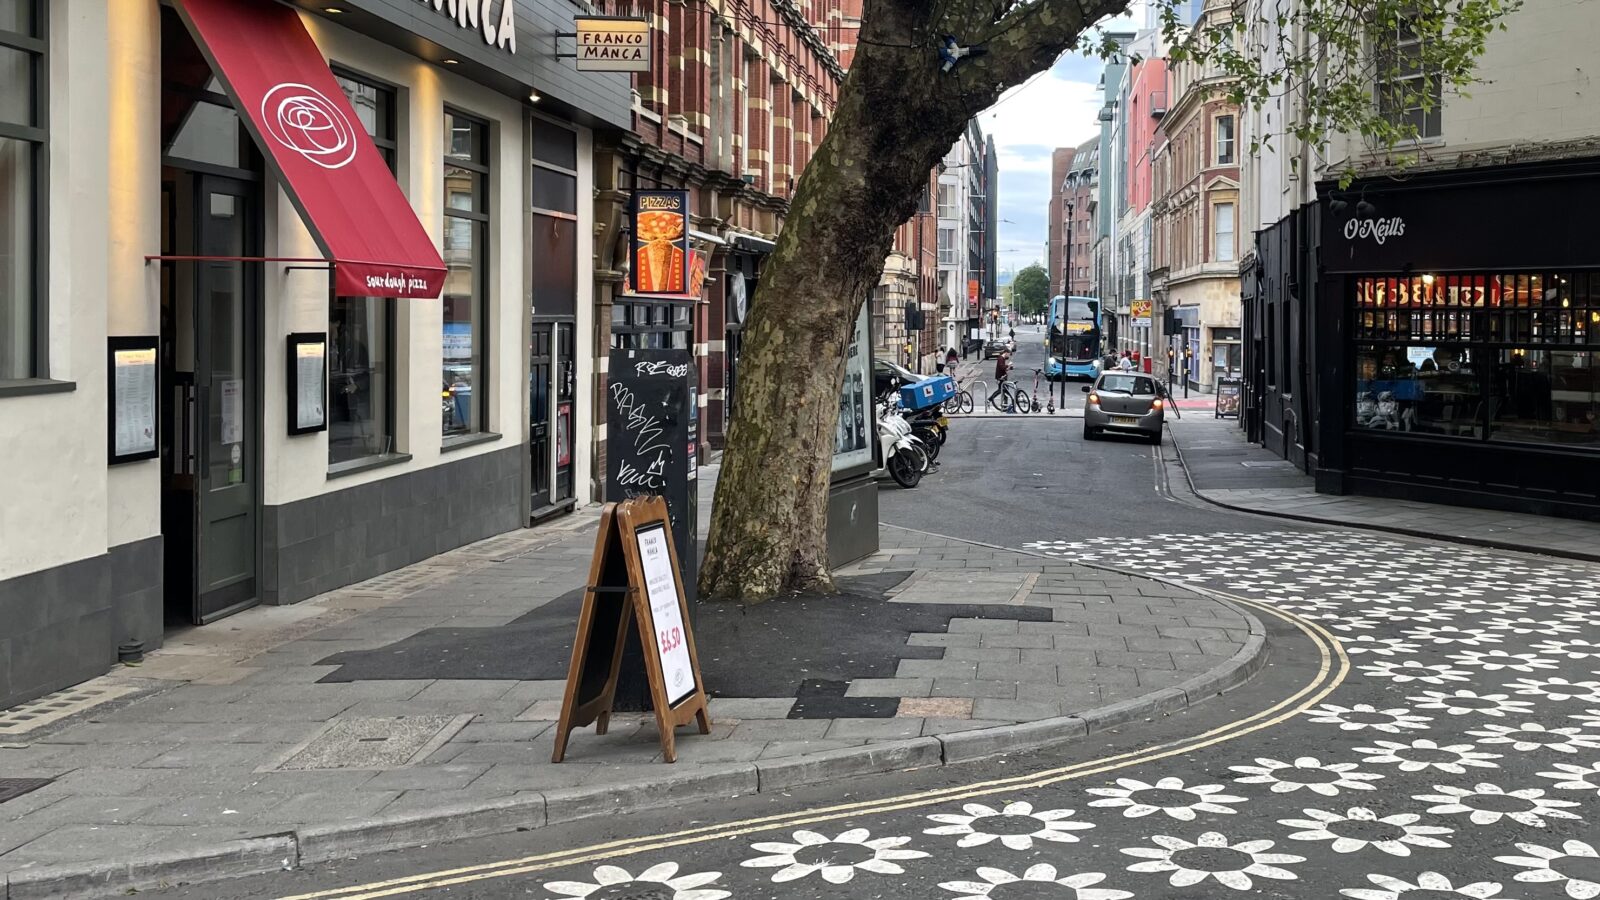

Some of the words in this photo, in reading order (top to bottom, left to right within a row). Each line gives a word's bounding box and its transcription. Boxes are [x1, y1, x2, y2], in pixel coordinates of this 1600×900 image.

[583, 33, 642, 44] FRANCO
[584, 46, 641, 60] MANCA
[640, 196, 680, 209] PIZZAS
[1344, 217, 1406, 245] O'Neill's
[366, 272, 406, 294] sourdough
[408, 274, 428, 294] pizza
